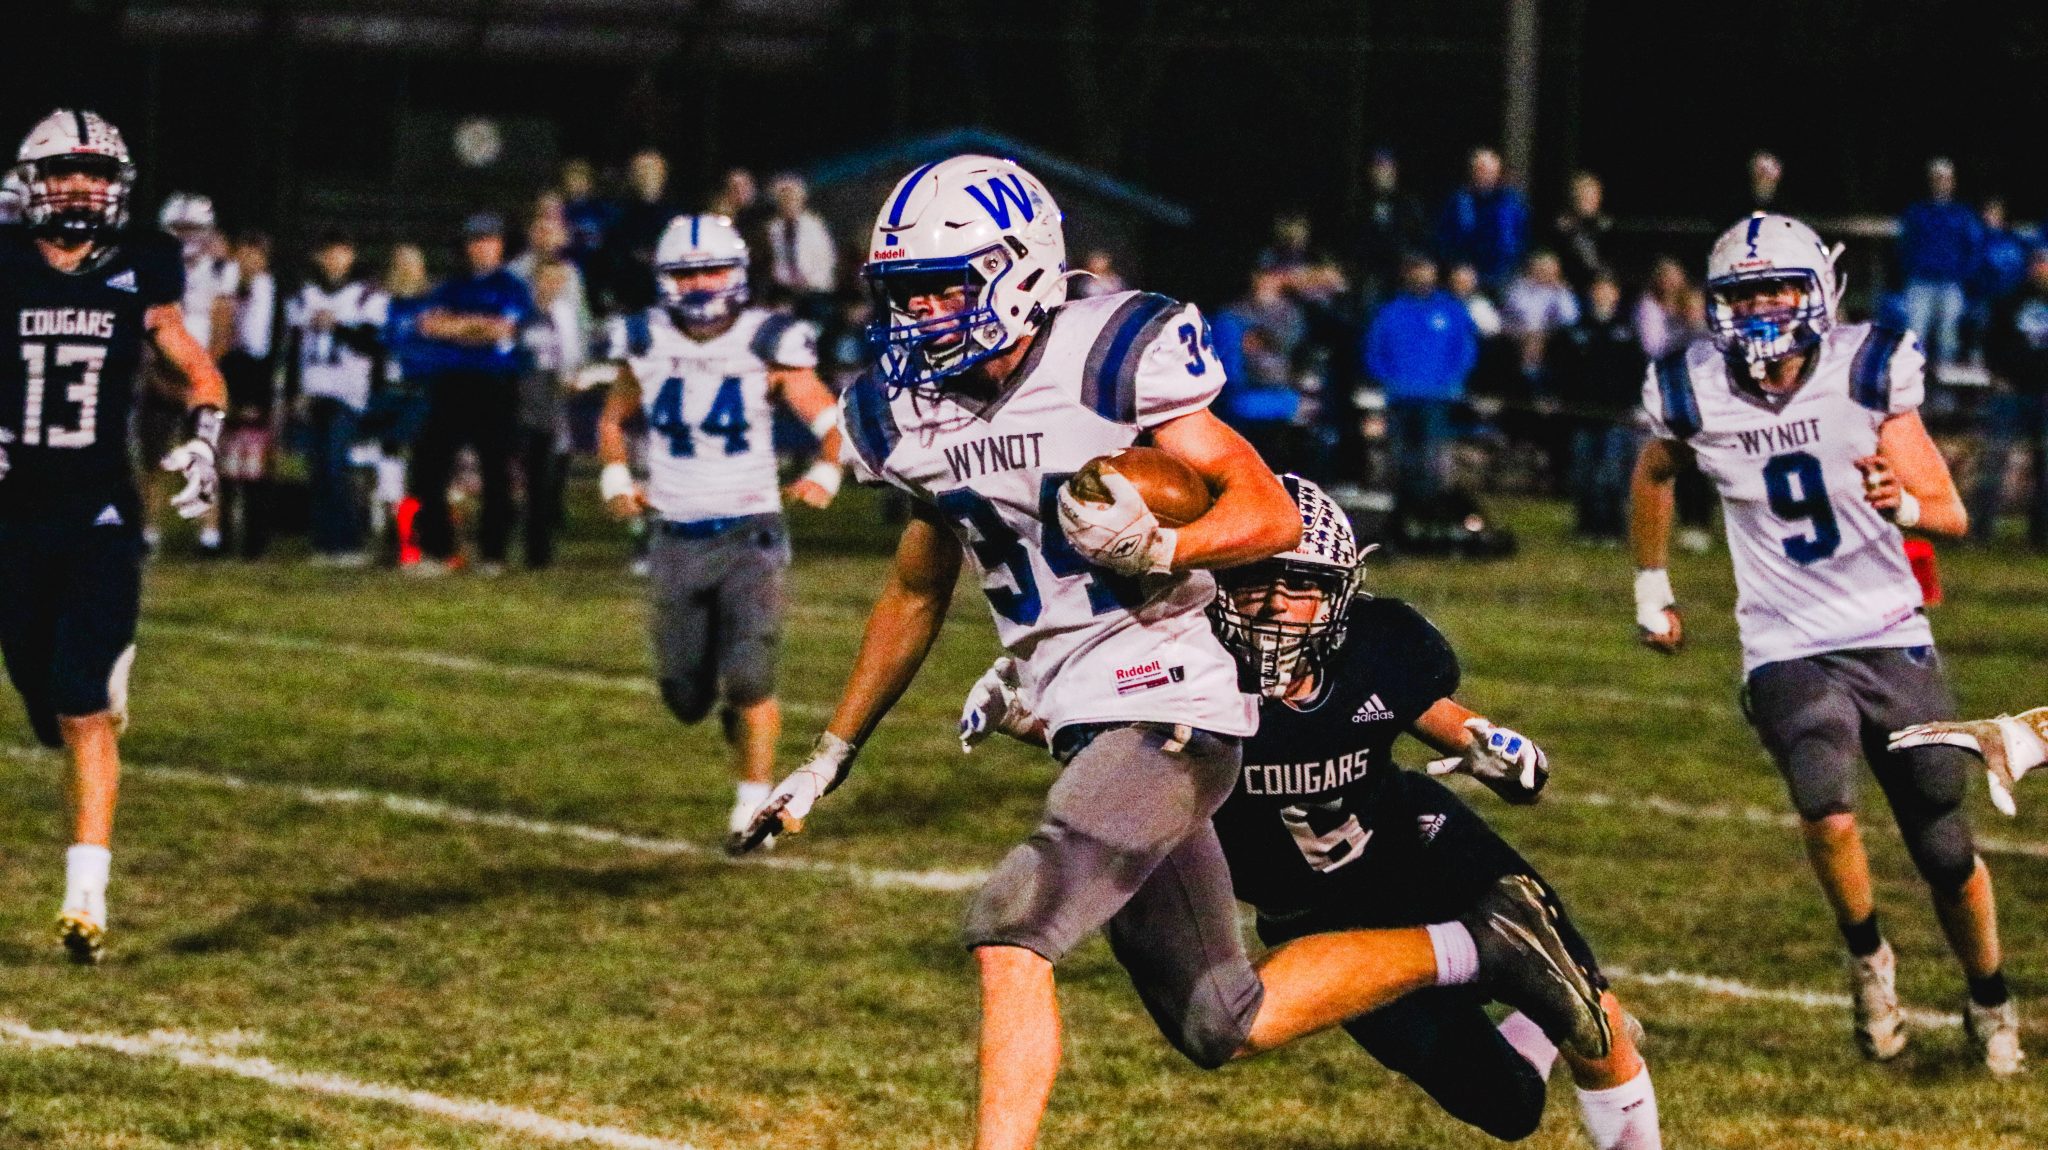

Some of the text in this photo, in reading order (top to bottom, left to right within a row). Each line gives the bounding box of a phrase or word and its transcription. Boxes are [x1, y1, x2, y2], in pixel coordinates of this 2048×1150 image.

[873, 249, 906, 261] Riddell
[20, 309, 115, 339] COUGARS
[21, 343, 108, 448] 13
[651, 376, 750, 457] 44
[944, 432, 1044, 483] WYNOT
[1737, 418, 1821, 456] WYNOT
[1762, 451, 1842, 565] 9
[1115, 660, 1162, 680] Riddell
[1351, 706, 1395, 724] adidas
[1243, 748, 1371, 796] COUGARS
